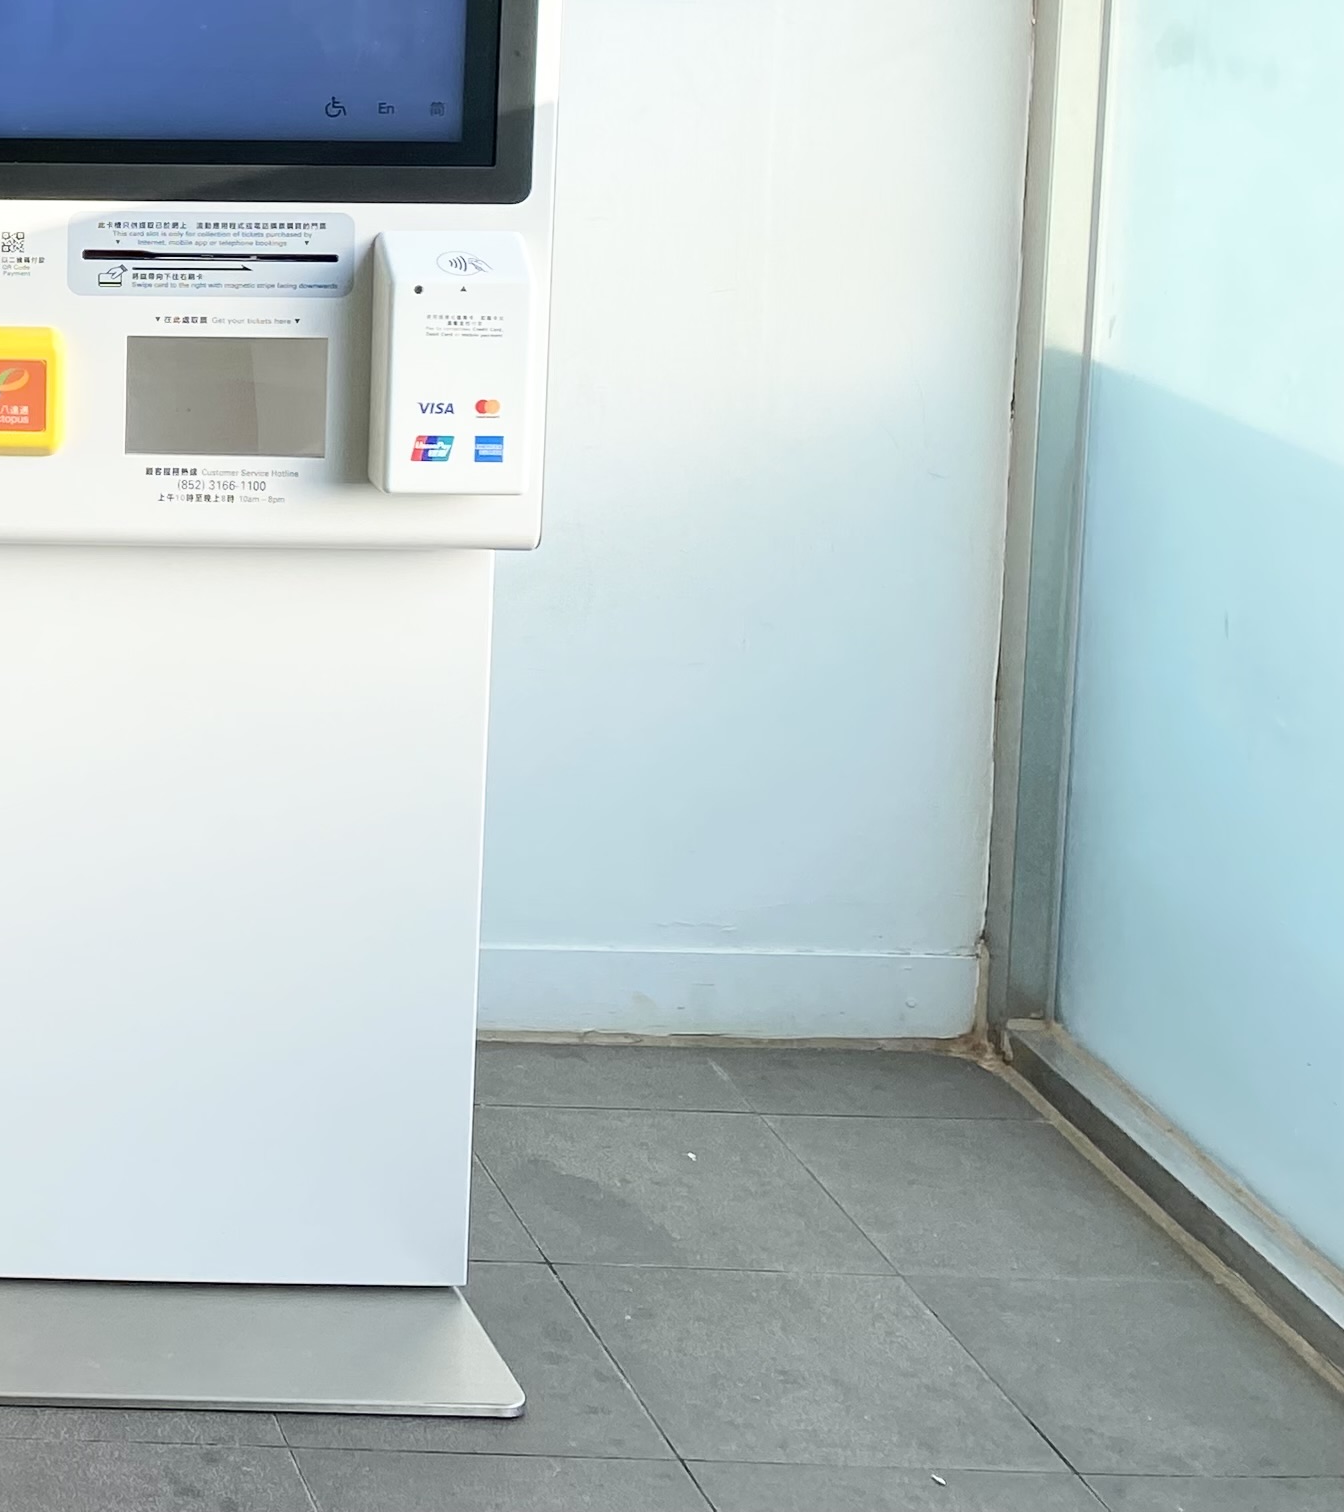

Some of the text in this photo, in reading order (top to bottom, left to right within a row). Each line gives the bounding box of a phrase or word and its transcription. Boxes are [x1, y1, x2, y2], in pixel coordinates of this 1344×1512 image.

[378, 102, 395, 114] En
[226, 318, 245, 326] your
[247, 317, 272, 325] tickets
[417, 402, 455, 415] VISA
[201, 468, 299, 478] Customer Service Hotline
[177, 479, 205, 491] (852)
[239, 495, 286, 504] 10am 8pm
